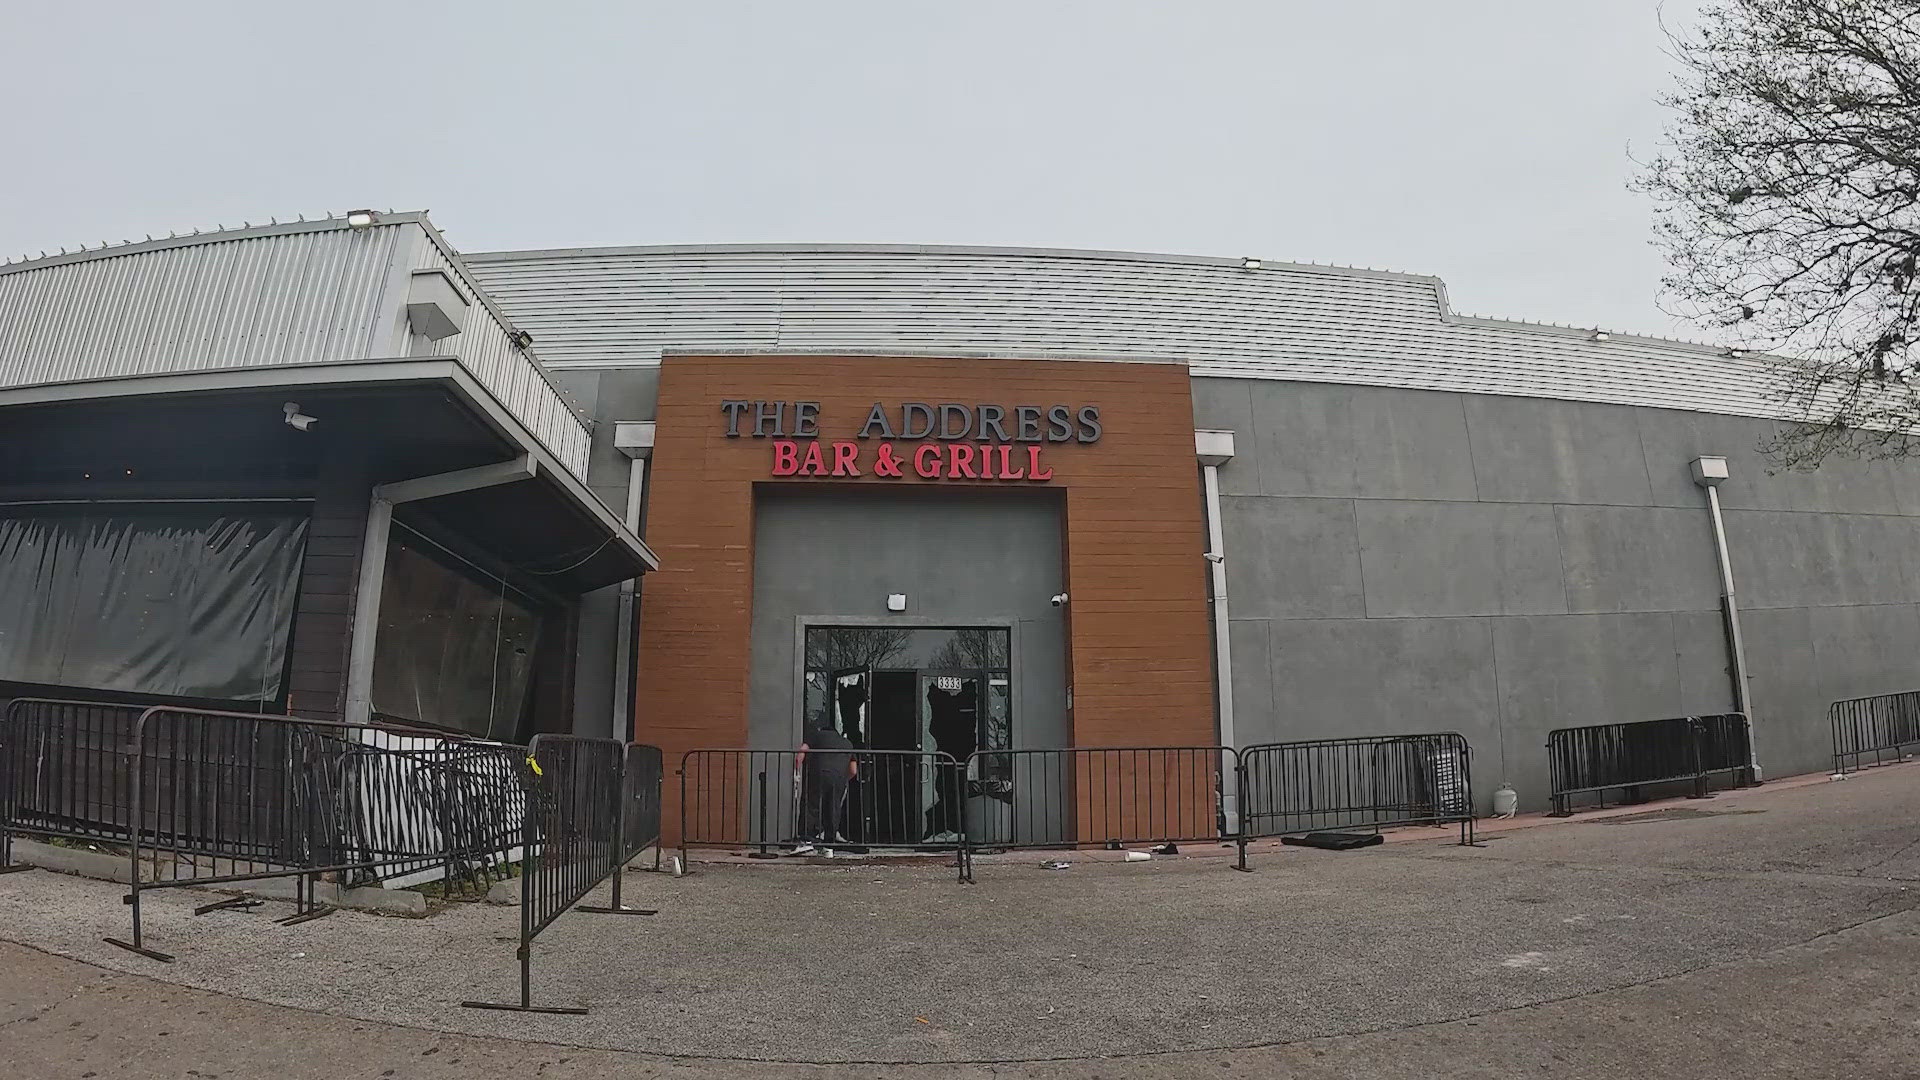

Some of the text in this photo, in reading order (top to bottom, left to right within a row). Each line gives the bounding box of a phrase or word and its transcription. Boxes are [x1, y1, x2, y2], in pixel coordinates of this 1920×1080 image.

[721, 399, 1102, 443] THE ADDRESS
[772, 440, 1054, 480] BAR & GRILL
[939, 677, 960, 689] 3333
